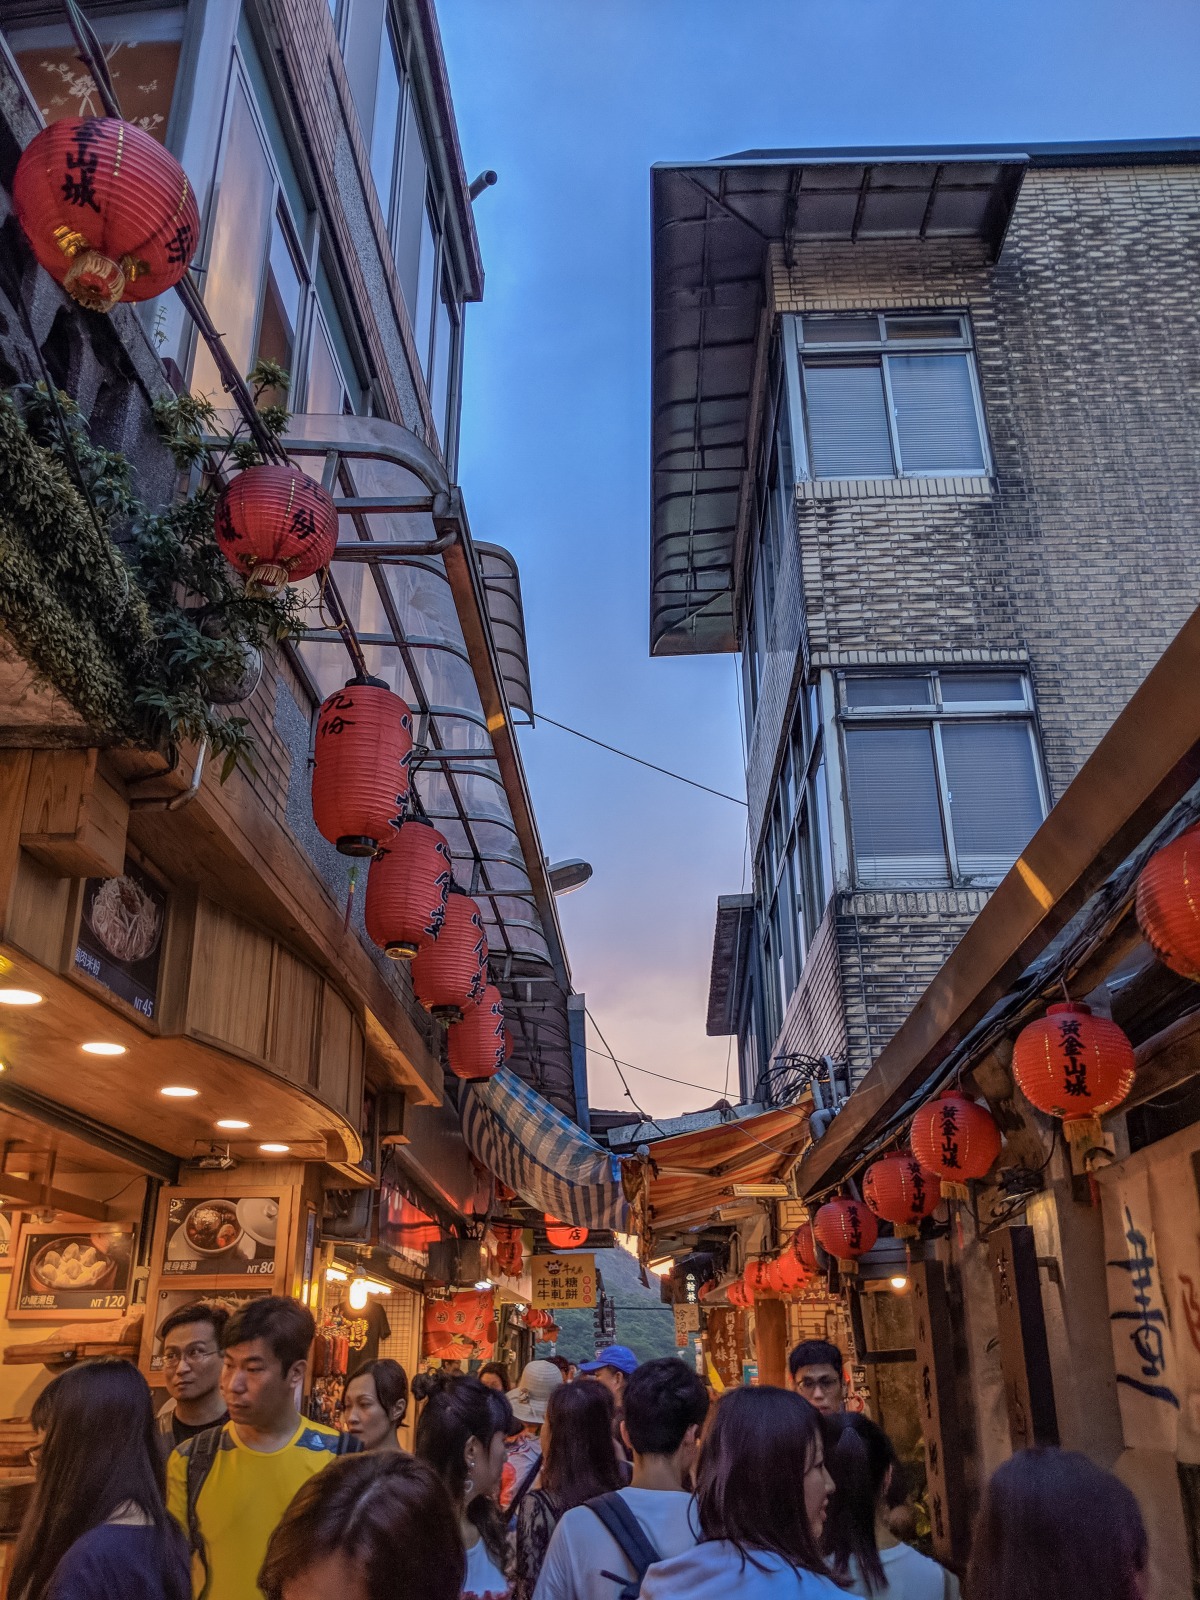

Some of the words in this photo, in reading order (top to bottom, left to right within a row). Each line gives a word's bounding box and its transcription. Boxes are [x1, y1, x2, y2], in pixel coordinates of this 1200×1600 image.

[321, 693, 355, 738] 九份
[133, 996, 143, 1011] NT
[142, 999, 154, 1018] 45
[1058, 1020, 1092, 1097] 黃金山城
[938, 1105, 961, 1169] 黃金山城
[569, 1228, 581, 1240] 店
[247, 1265, 259, 1274] NT
[259, 1261, 275, 1274] 80
[537, 1278, 578, 1289] 牛軋糖
[90, 1299, 103, 1308] NT
[104, 1295, 125, 1308] 120
[537, 1289, 578, 1301] 牛軋餅
